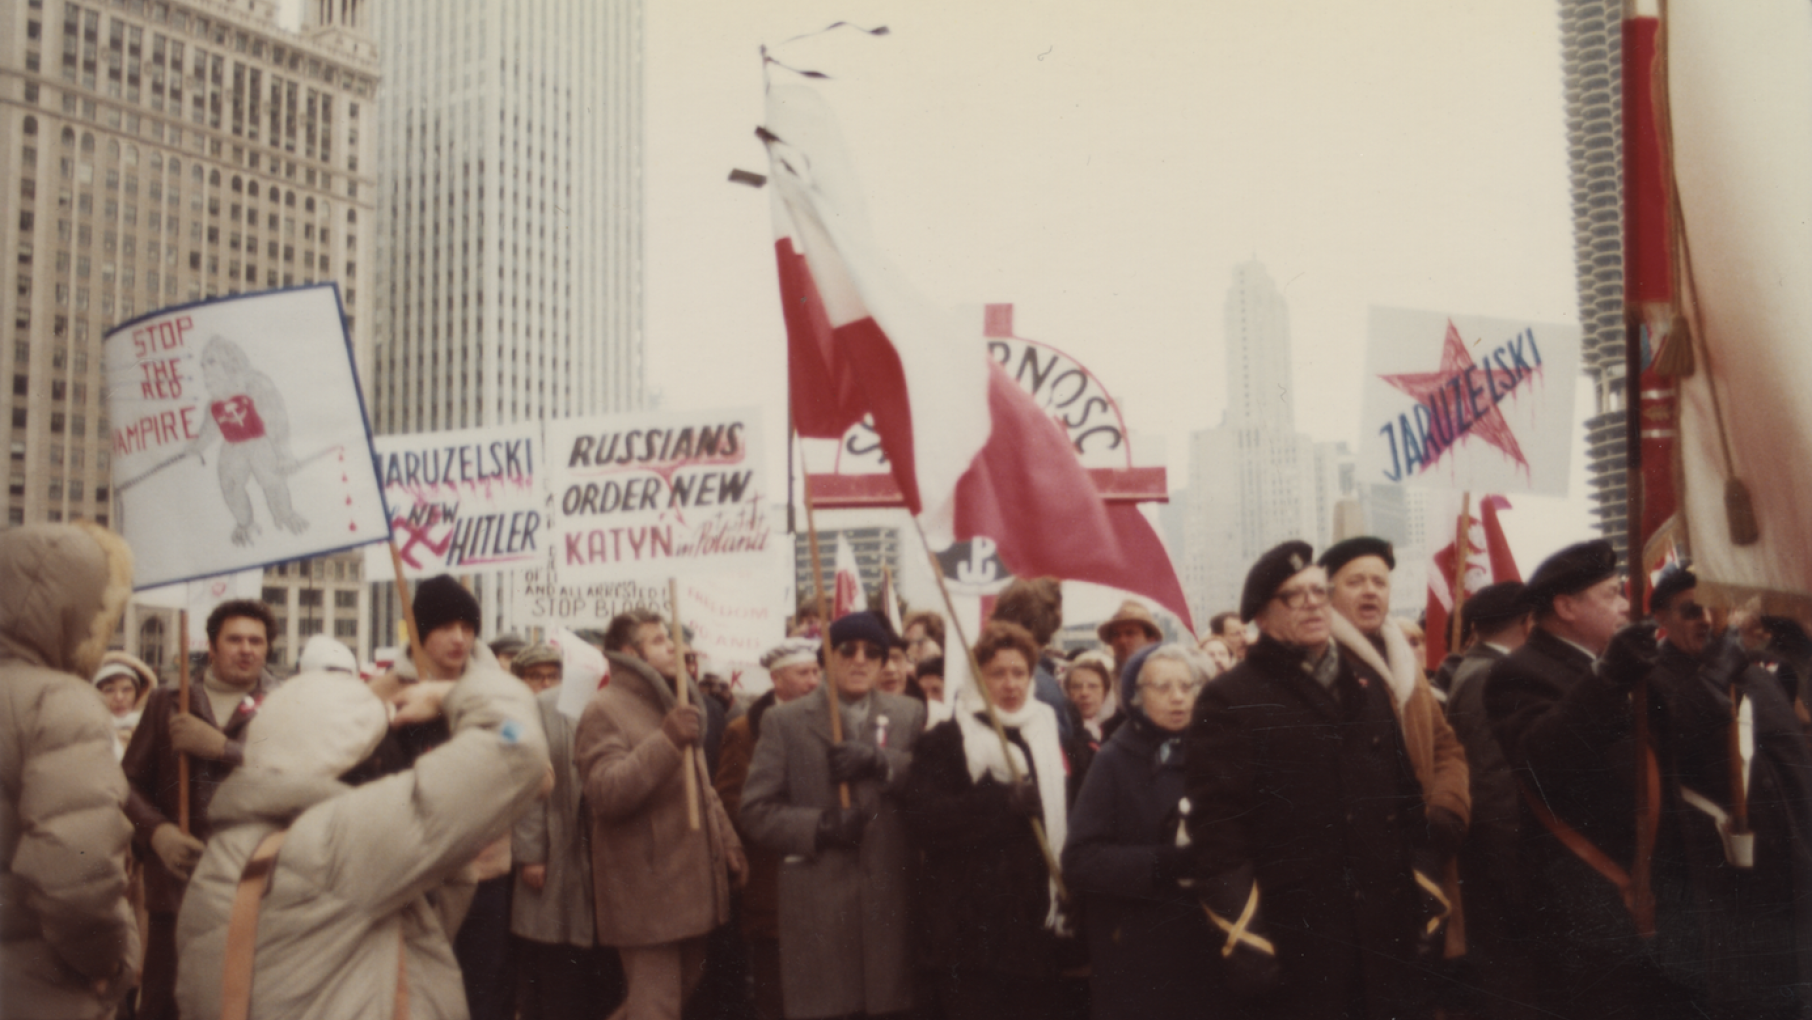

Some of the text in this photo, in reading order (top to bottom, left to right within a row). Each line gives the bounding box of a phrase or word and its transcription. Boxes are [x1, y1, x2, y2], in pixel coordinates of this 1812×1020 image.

[132, 315, 194, 358] STOP
[140, 358, 184, 383] THE
[141, 380, 184, 401] RED
[1379, 326, 1542, 483] JARUZELSKI
[567, 421, 745, 468] RUSSIANS
[406, 500, 459, 528] NEW
[562, 469, 753, 517] ORDER NEW
[446, 510, 541, 566] HITLER
[532, 598, 586, 617] STOP
